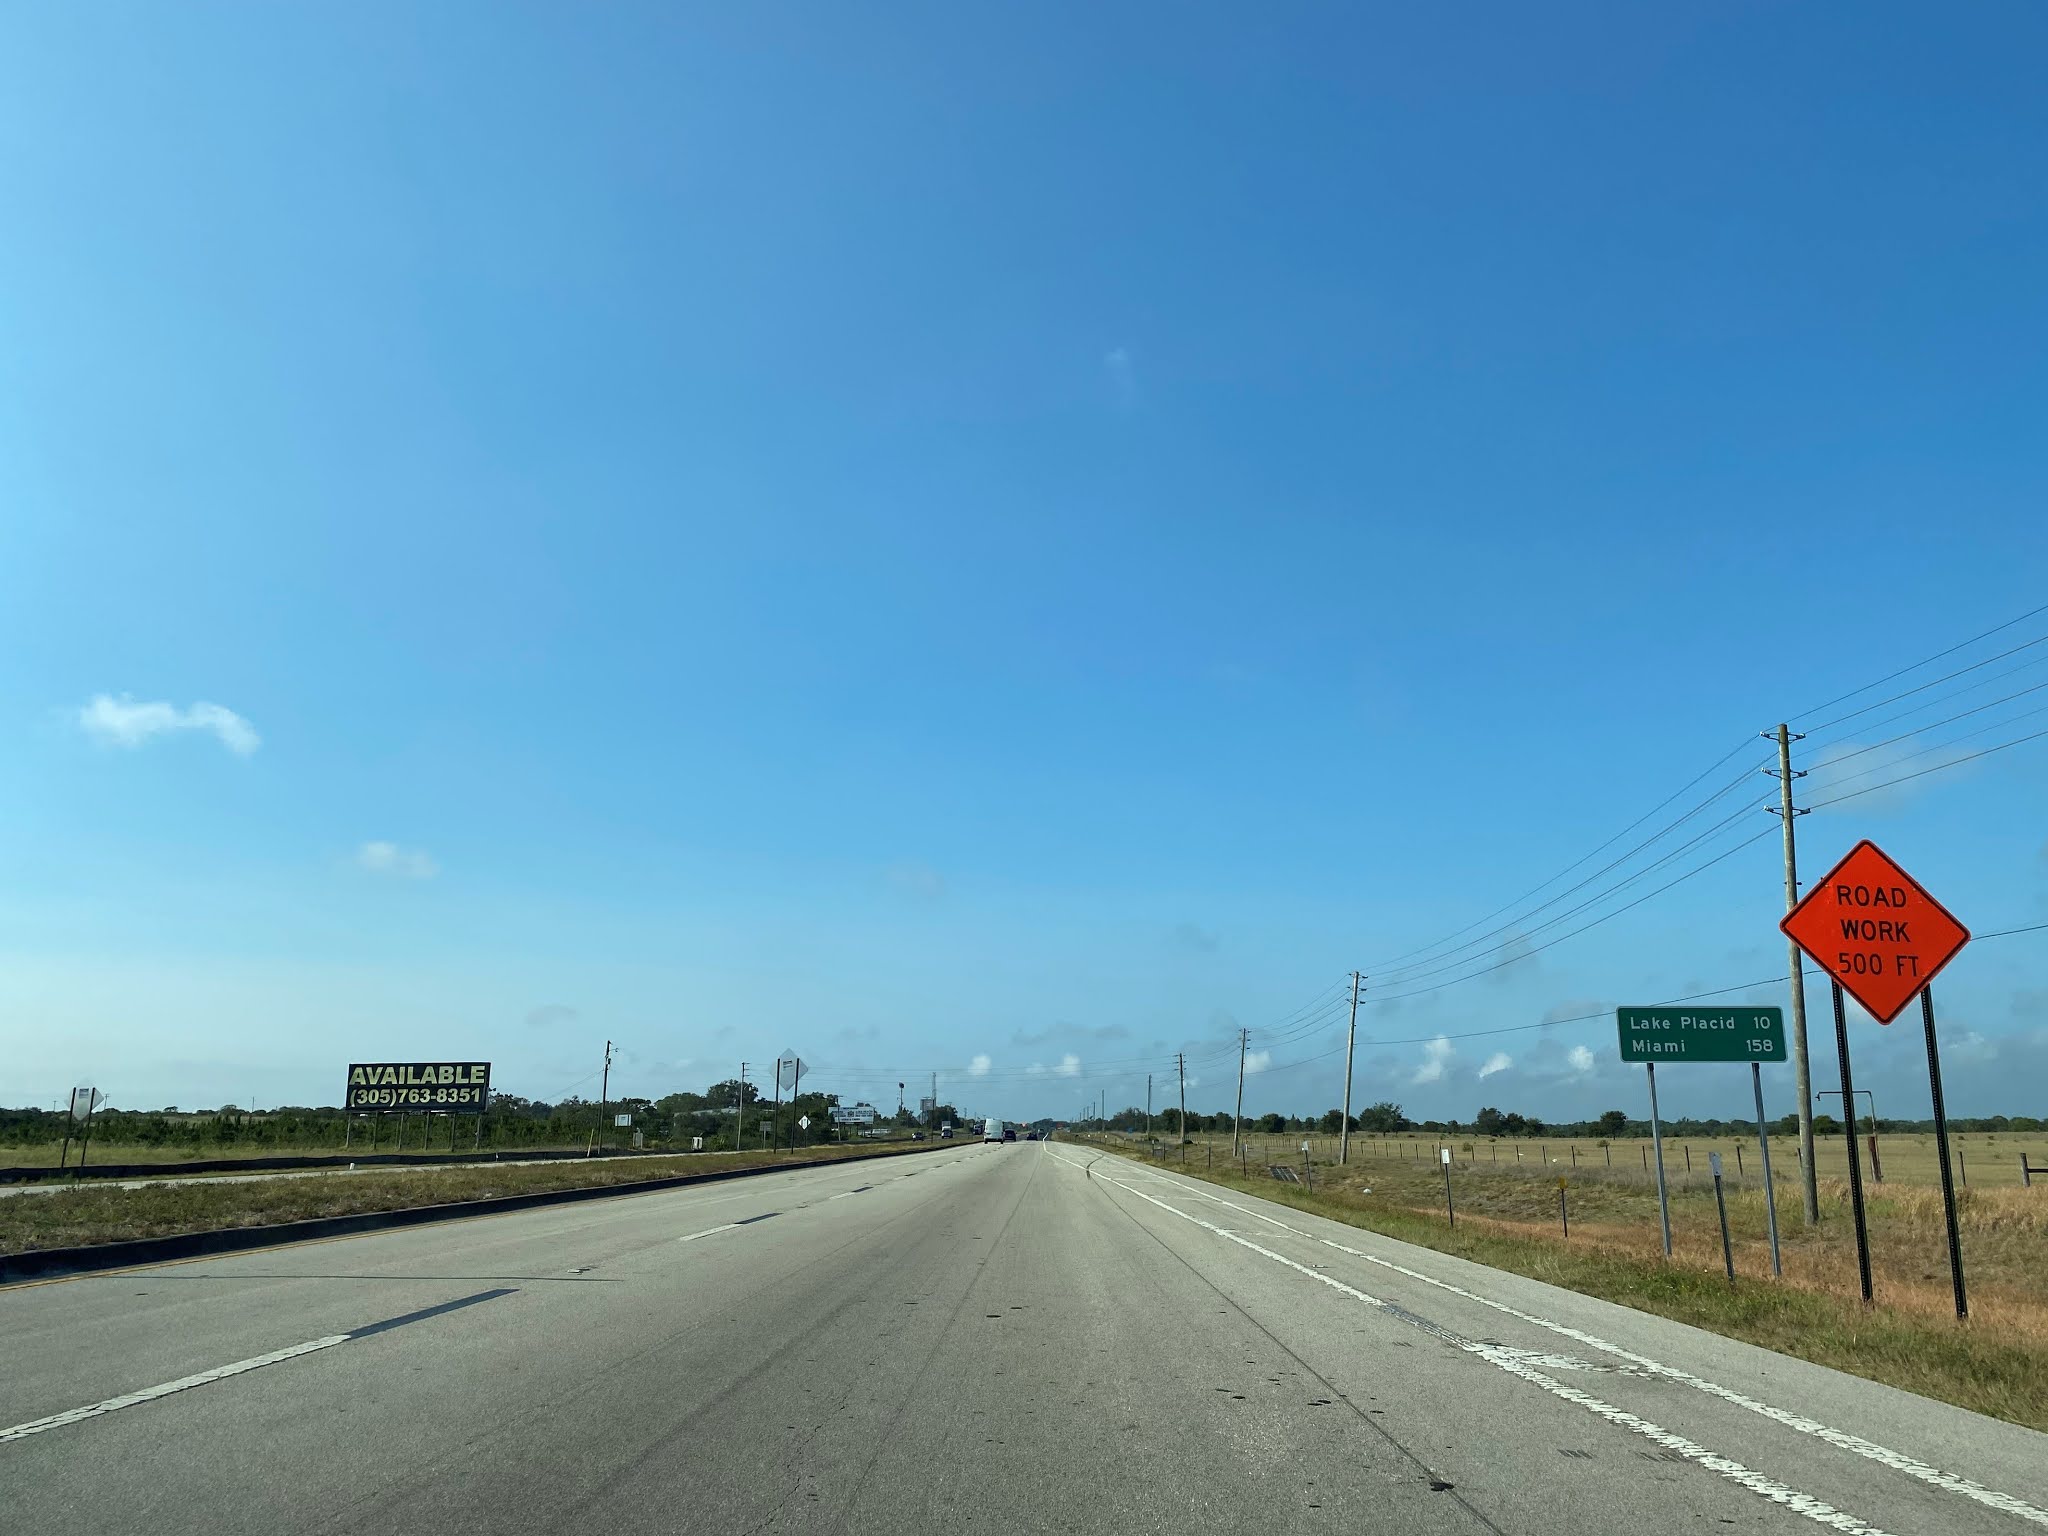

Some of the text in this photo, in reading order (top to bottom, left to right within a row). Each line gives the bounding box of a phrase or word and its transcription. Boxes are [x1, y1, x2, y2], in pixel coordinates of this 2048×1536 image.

[1837, 885, 1907, 908] ROAD
[1840, 919, 1911, 943] WORK
[1838, 952, 1919, 977] 500 FT
[1630, 1016, 1771, 1030] Lake Placid 10
[1632, 1039, 1774, 1053] Miami 158
[349, 1065, 486, 1085] AVAILABLE
[349, 1088, 480, 1107] (305)763-8351
